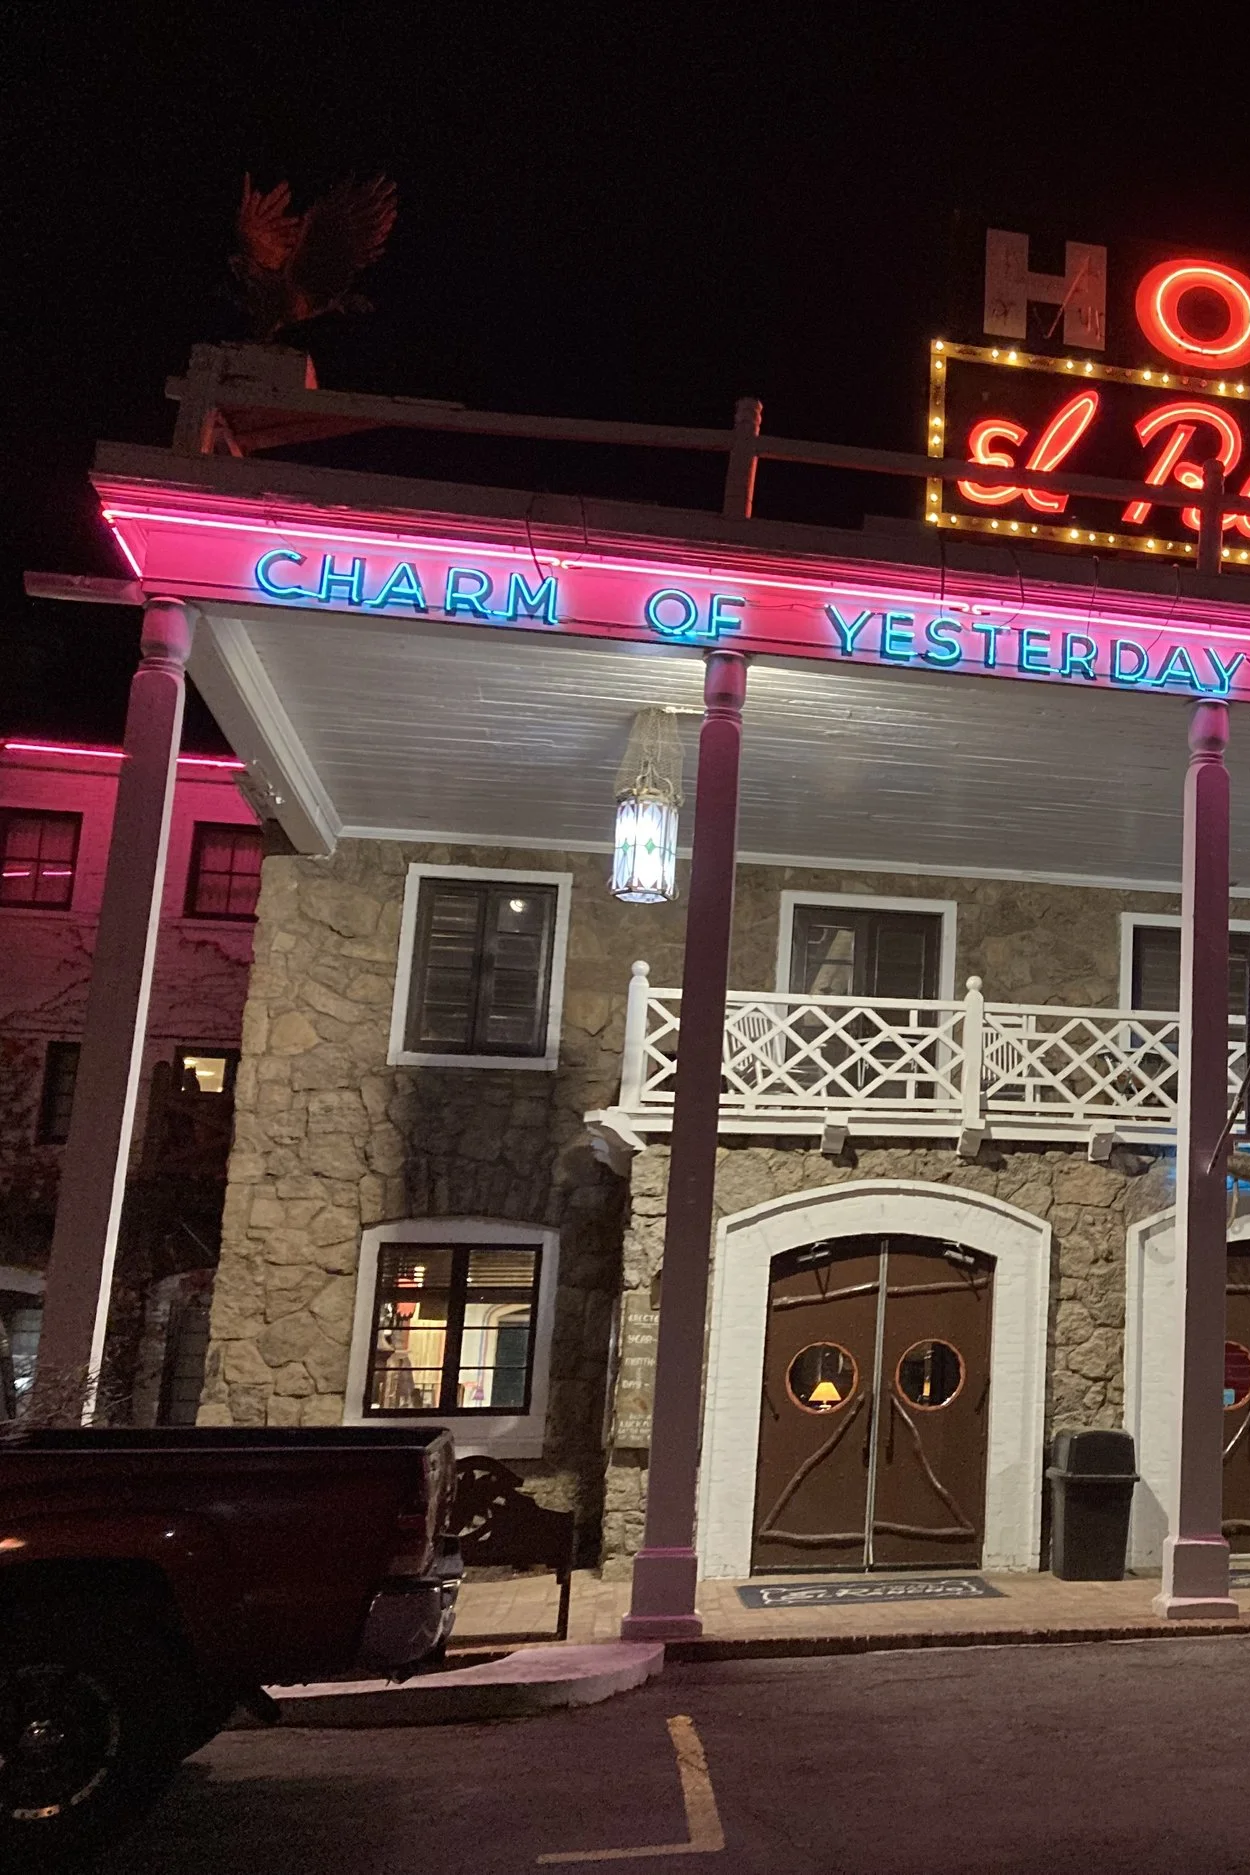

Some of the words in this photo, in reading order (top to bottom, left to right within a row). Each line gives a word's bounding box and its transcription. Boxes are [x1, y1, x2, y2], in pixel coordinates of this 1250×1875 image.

[256, 548, 559, 626] CHARM
[645, 587, 746, 638] OF
[824, 603, 1247, 695] YESTERDAY
